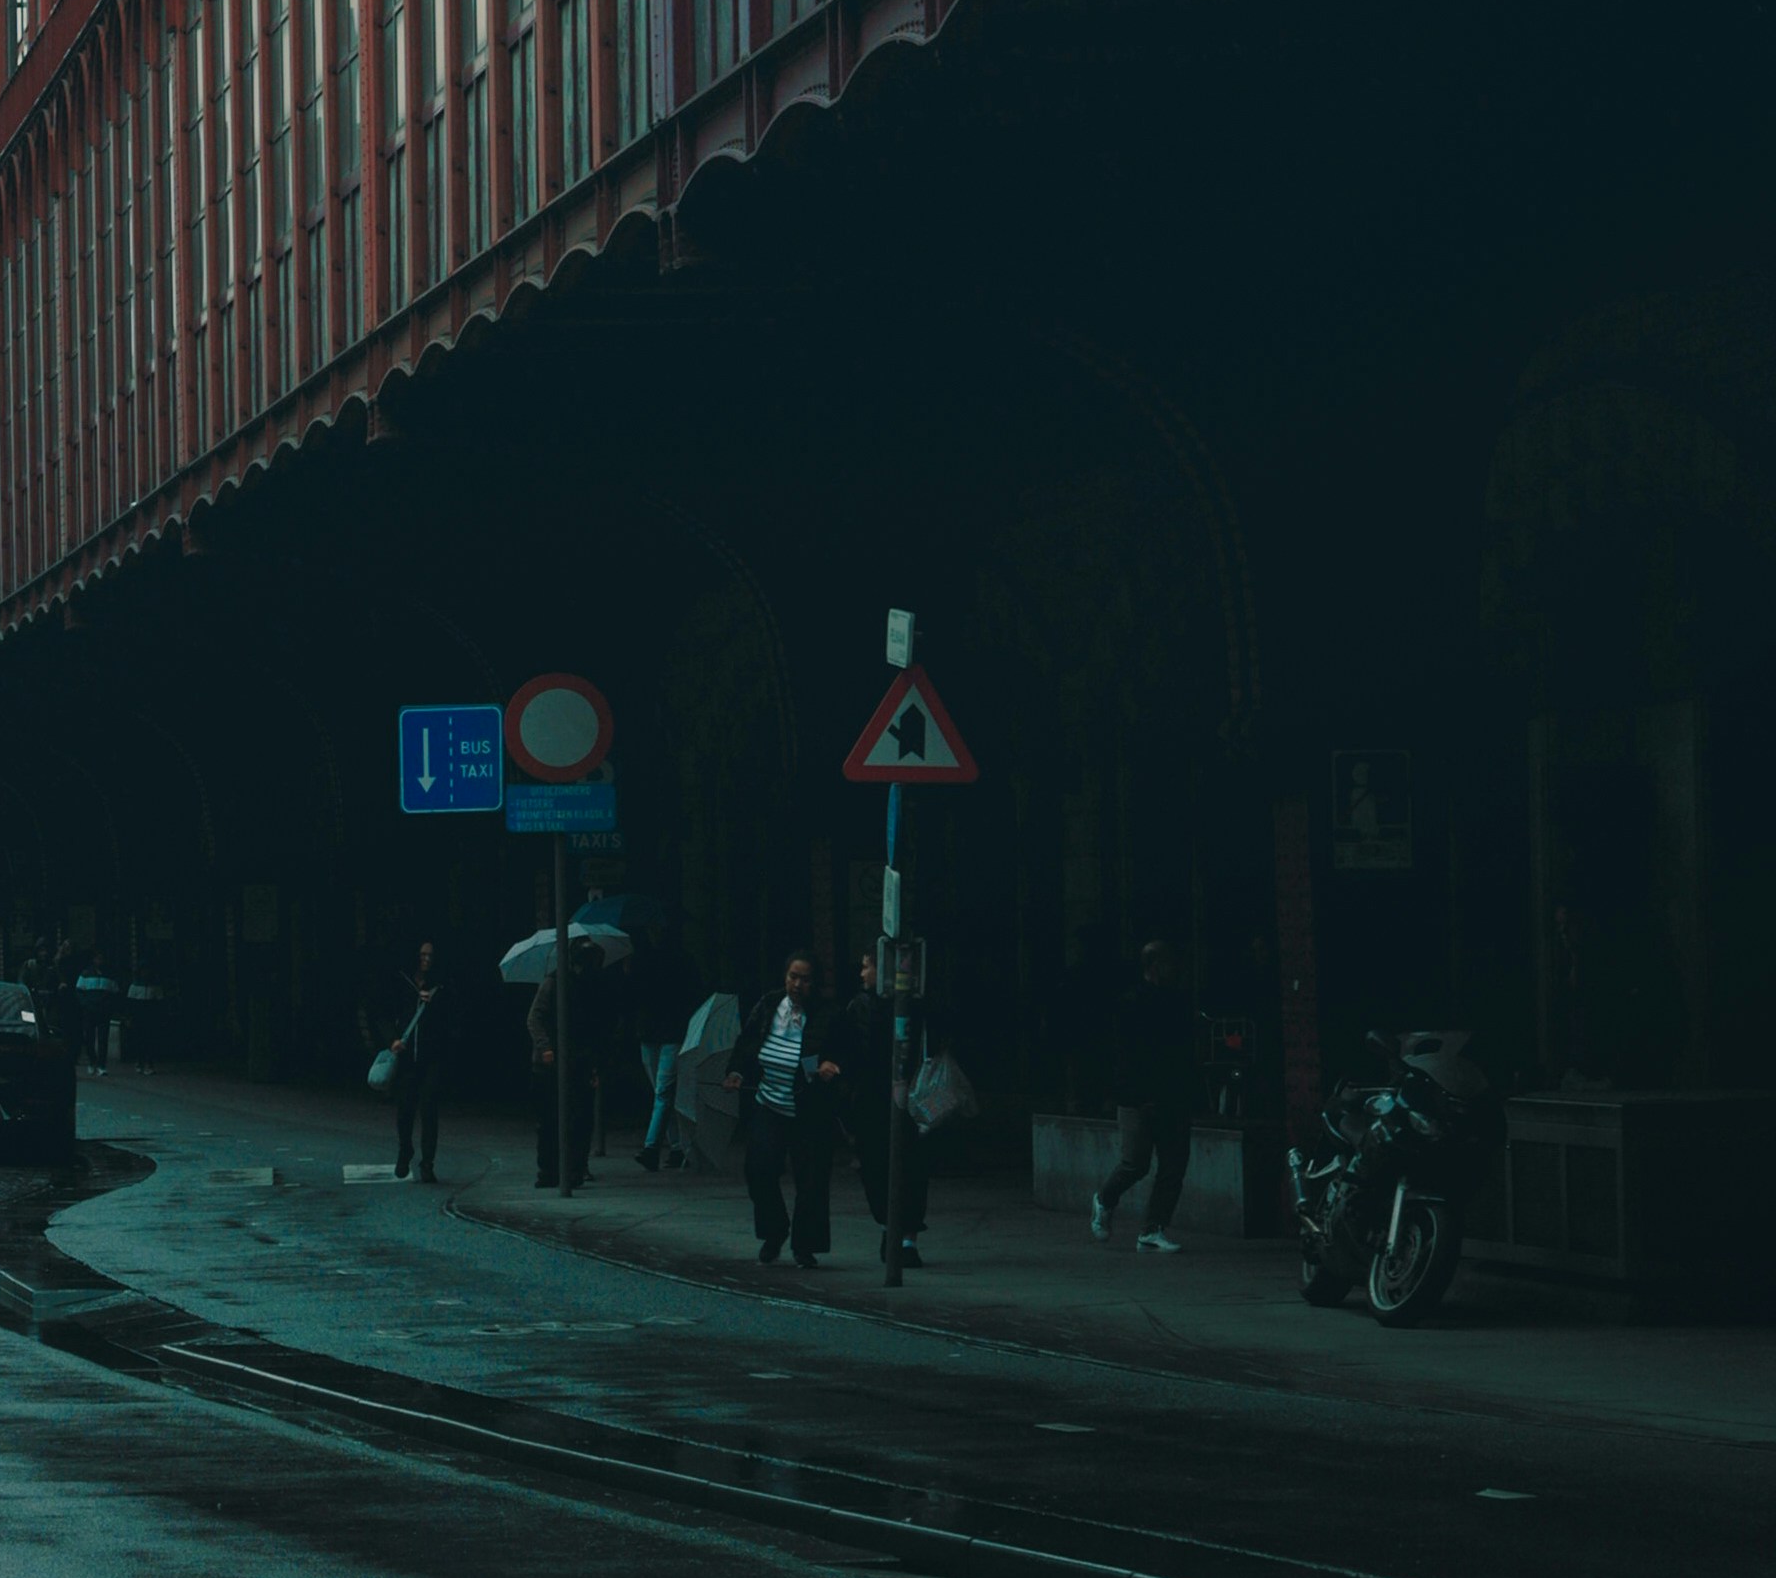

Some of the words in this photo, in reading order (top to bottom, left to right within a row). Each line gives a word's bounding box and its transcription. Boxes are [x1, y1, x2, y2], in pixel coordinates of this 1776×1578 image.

[460, 740, 491, 755] BUS
[459, 763, 494, 779] TAXI
[570, 832, 622, 849] TAXI'S
